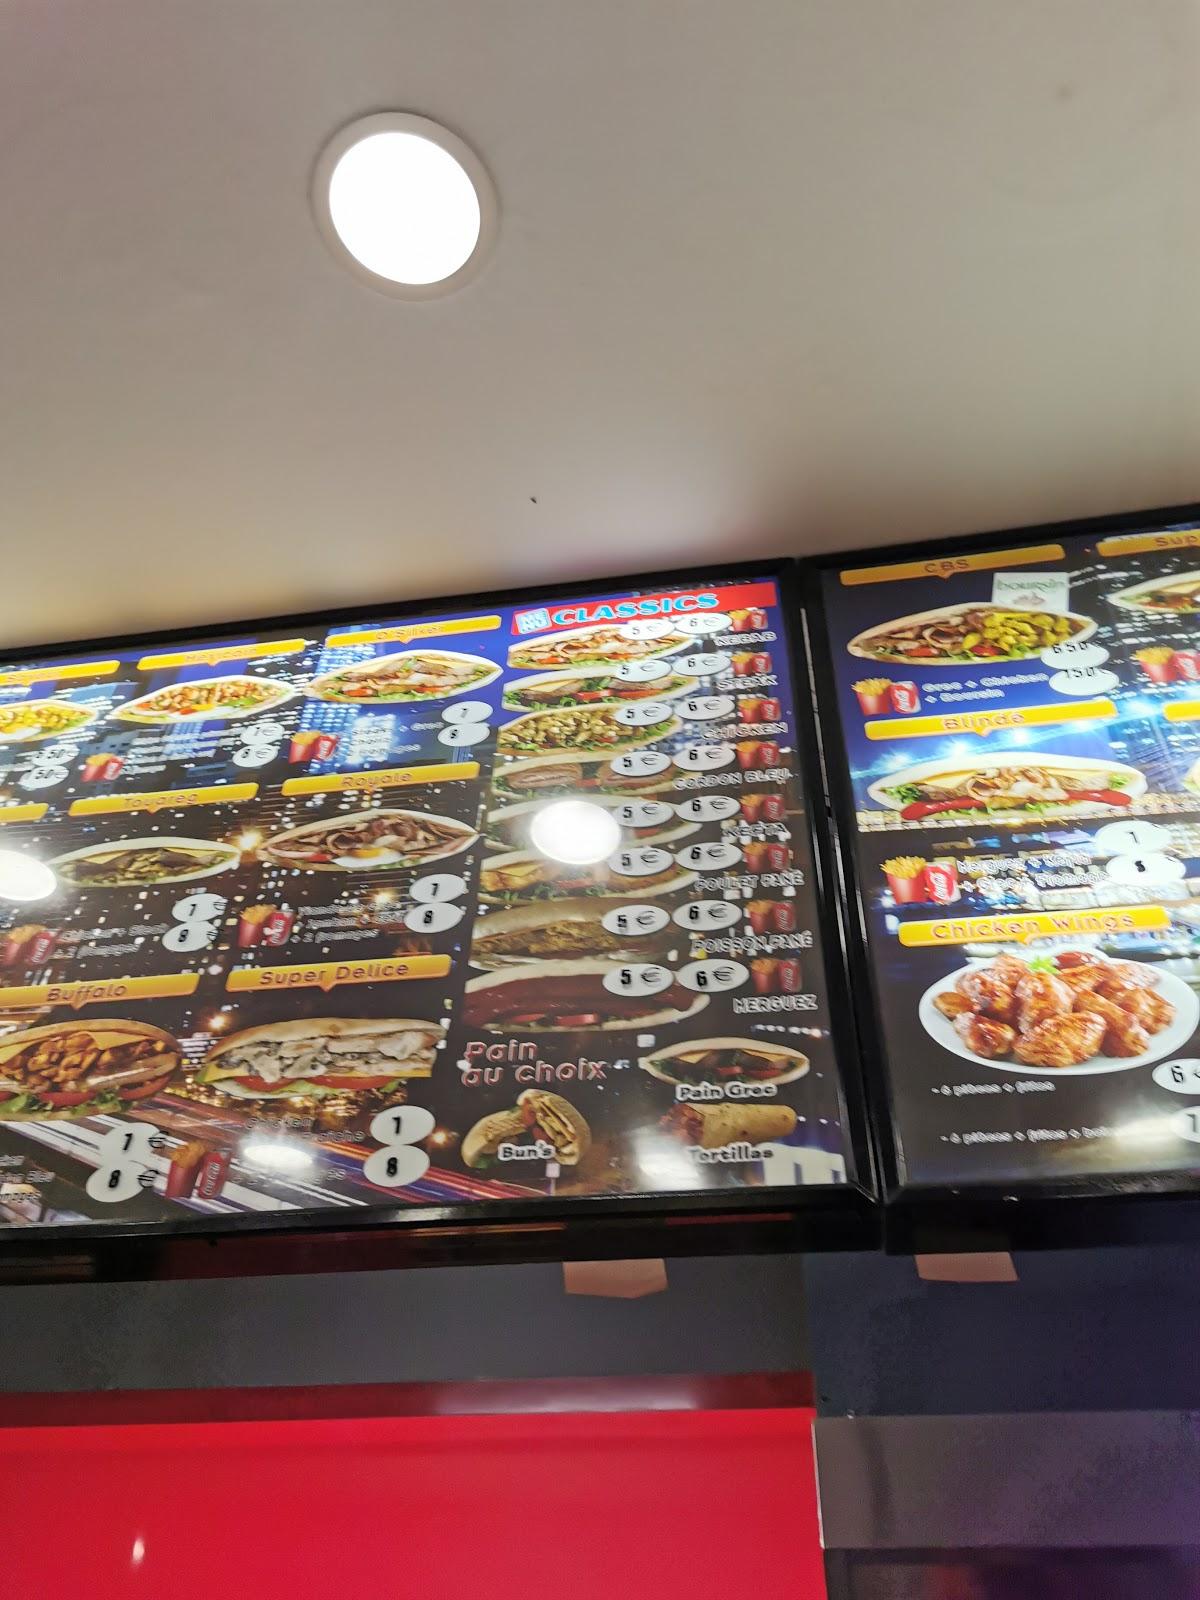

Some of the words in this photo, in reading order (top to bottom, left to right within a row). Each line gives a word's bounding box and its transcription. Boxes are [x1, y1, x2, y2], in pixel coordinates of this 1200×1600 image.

[551, 593, 719, 626] CLASSICS
[623, 756, 632, 768] 5
[689, 749, 698, 761] 6
[672, 772, 742, 790] CORDON
[623, 806, 632, 818] 5
[692, 799, 701, 812] 6
[621, 853, 631, 867] 5
[691, 847, 701, 860] 6
[617, 914, 627, 928] 5
[689, 906, 699, 920] 6
[932, 919, 1040, 939] Chicken
[1053, 913, 1135, 932] Wings
[260, 970, 325, 986] Super
[335, 962, 409, 980] Delice
[621, 969, 631, 986] 5
[696, 970, 708, 987] 6
[47, 984, 127, 1001] Buffalo
[732, 994, 818, 1014] MERGUEZ
[464, 1039, 538, 1062] Pain
[461, 1067, 504, 1087] au
[515, 1057, 608, 1083] choix
[678, 1082, 723, 1100] Pain
[726, 1082, 777, 1098] Grec
[386, 1157, 398, 1178] 8
[108, 1169, 121, 1188] 8
